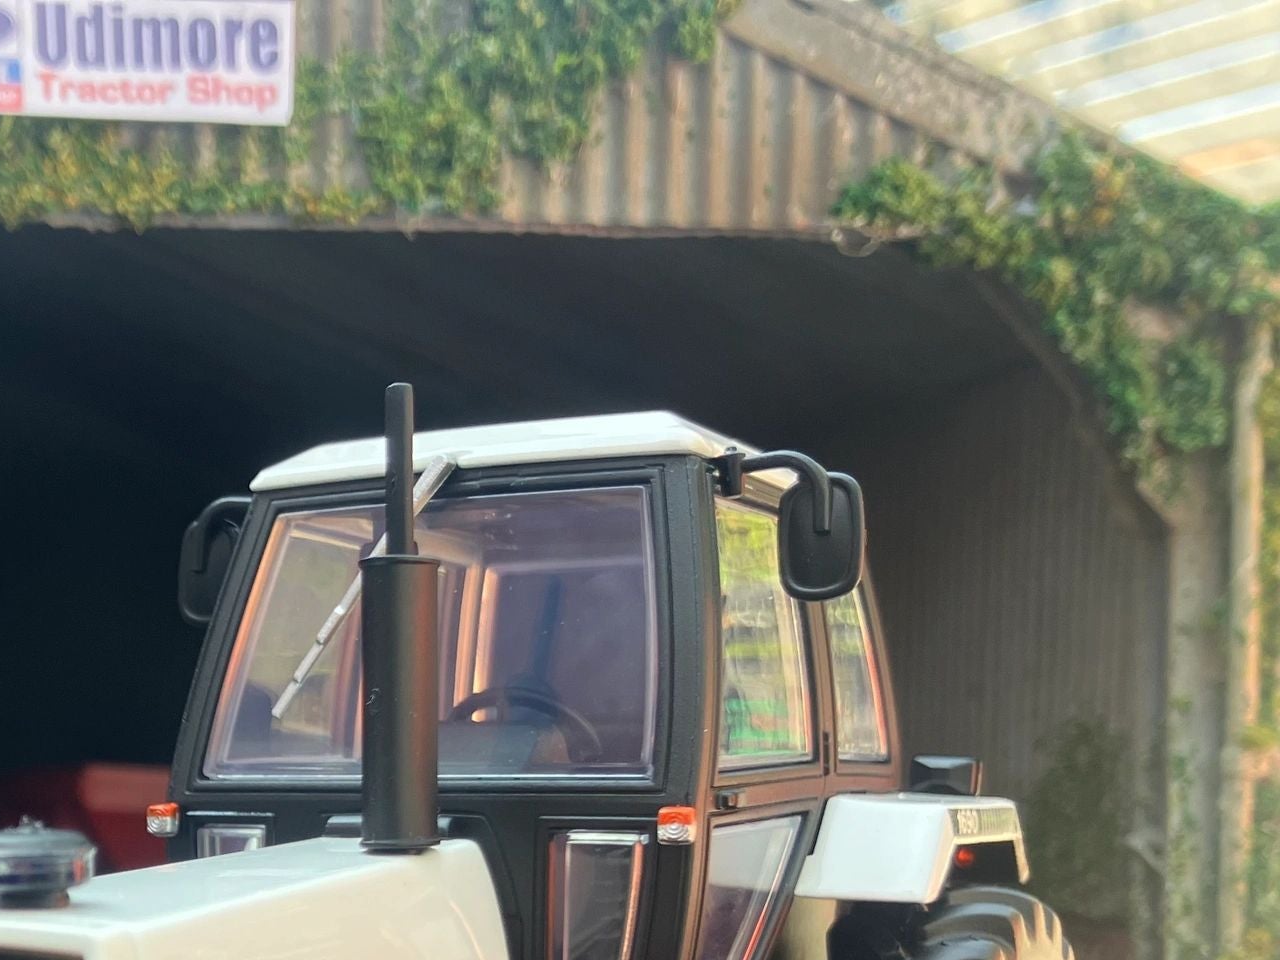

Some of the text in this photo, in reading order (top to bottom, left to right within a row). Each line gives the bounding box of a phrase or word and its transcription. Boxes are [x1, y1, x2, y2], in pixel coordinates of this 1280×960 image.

[34, 2, 280, 74] Udimore
[36, 71, 176, 104] Tractor
[186, 74, 279, 113] Shop
